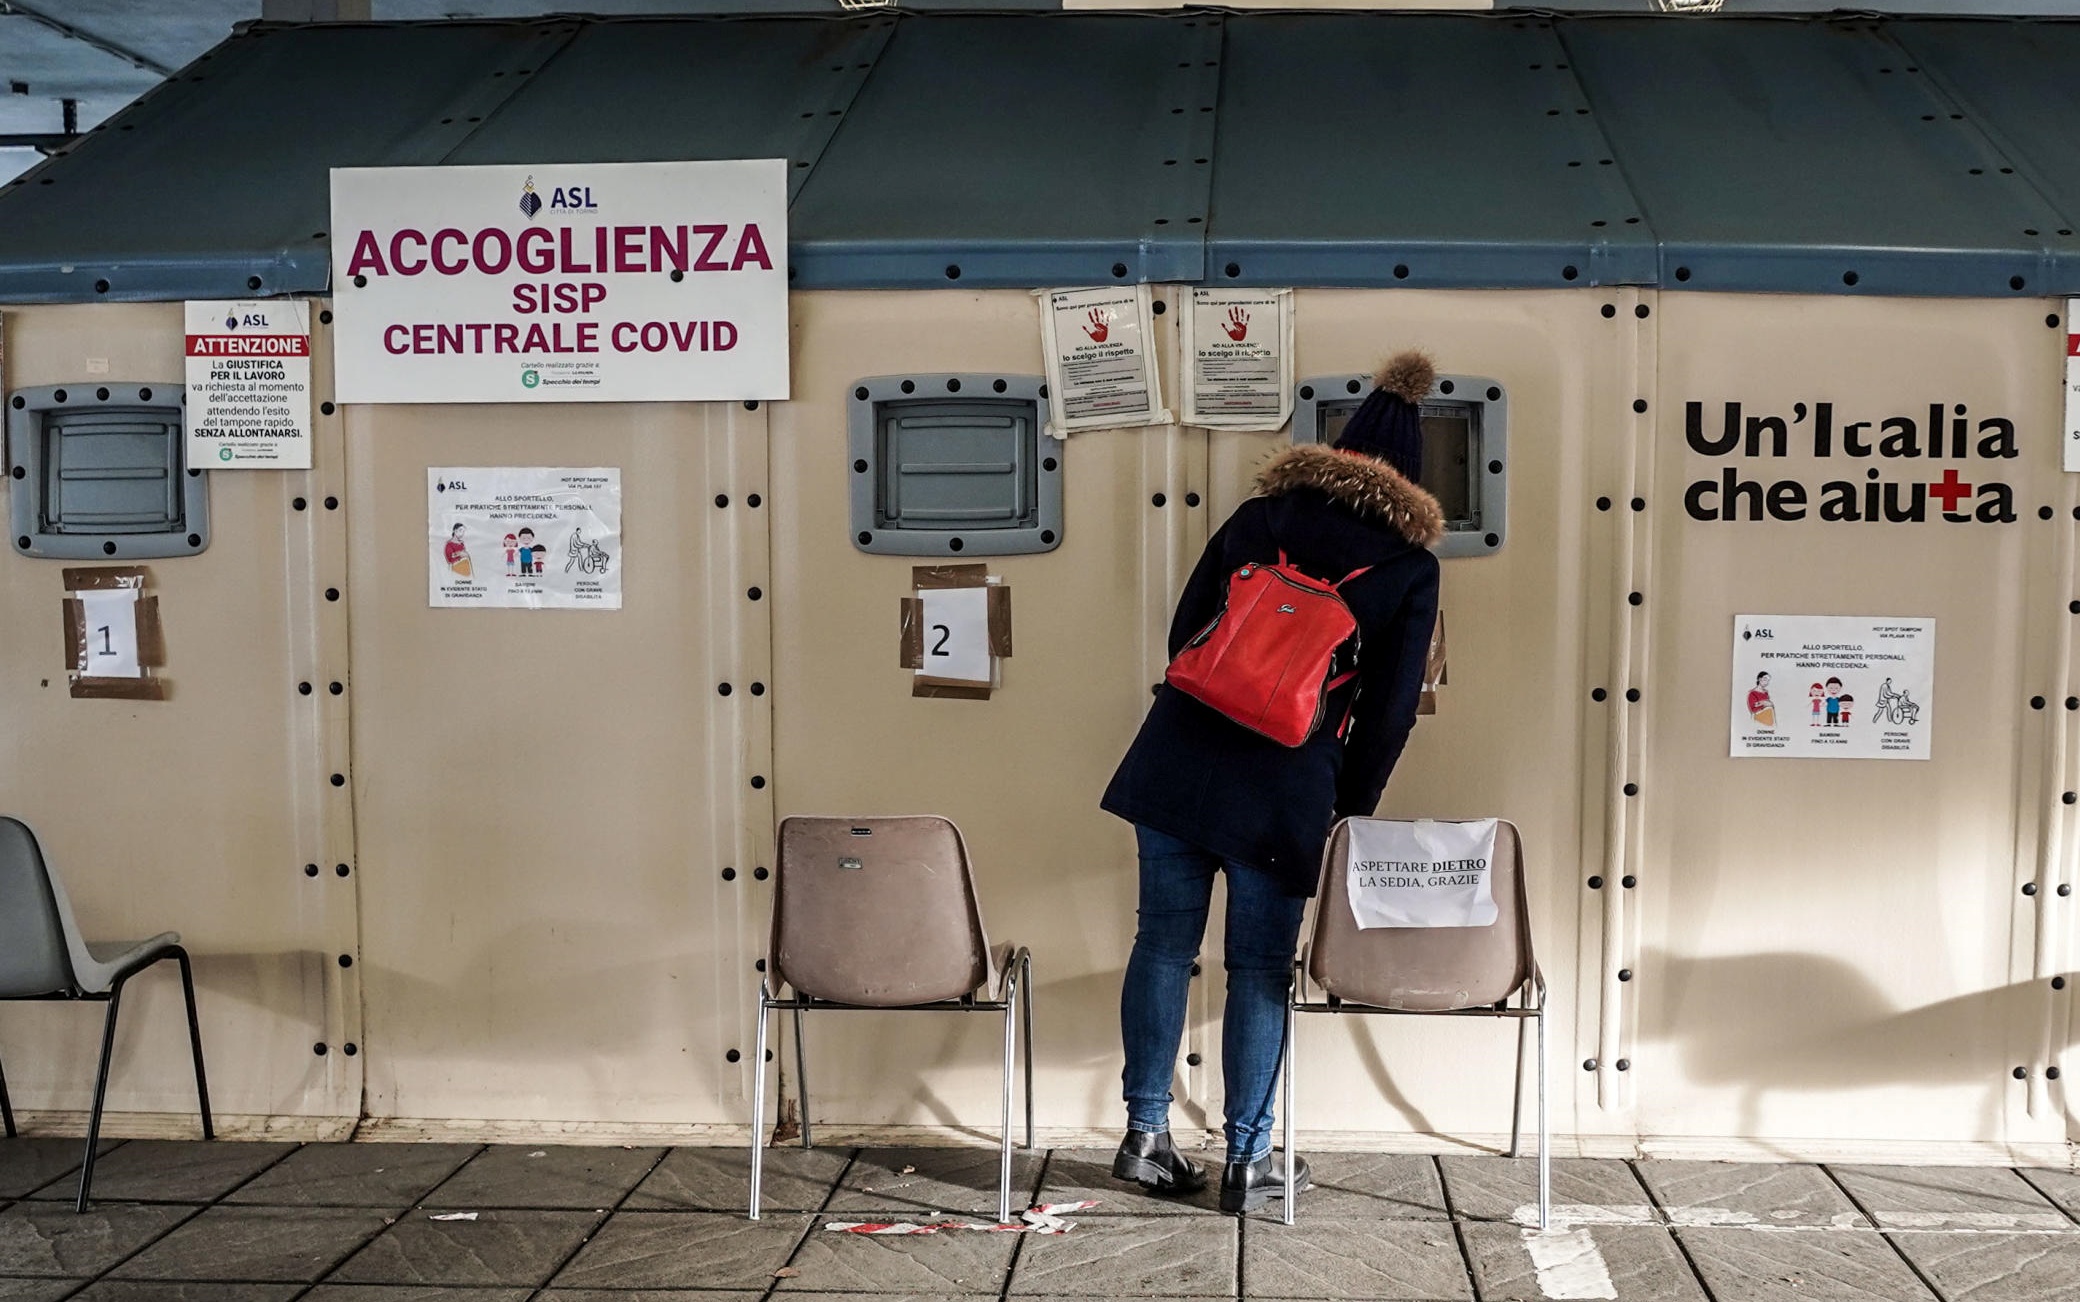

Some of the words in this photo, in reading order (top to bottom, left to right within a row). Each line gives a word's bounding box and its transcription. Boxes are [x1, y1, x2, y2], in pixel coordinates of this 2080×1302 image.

[551, 187, 597, 208] ASL
[347, 223, 773, 276] ACCOGLIENZA
[513, 283, 606, 314] SISP
[243, 314, 268, 326] ASL
[384, 323, 599, 354] CENTRALE
[611, 321, 737, 353] COVID
[194, 338, 302, 353] ATTENZIONE
[1072, 351, 1096, 361] scelgo
[1105, 348, 1134, 357] rispetto
[213, 360, 224, 369] La
[226, 360, 283, 369] GIUSTIFICA
[211, 371, 230, 380] PER
[233, 371, 241, 380] IL
[244, 371, 285, 380] LAVORO
[205, 382, 245, 391] richiesta
[248, 382, 256, 391] al
[209, 394, 287, 402] dell'accettazione
[207, 407, 260, 415] attendendo
[263, 407, 290, 415] l'esito
[203, 418, 217, 427] del
[220, 419, 261, 428] tampone
[264, 418, 293, 428] rapido
[195, 429, 225, 437] SENZA
[228, 429, 302, 438] ALLONTANARSI.
[449, 482, 467, 490] ASL
[1684, 467, 1807, 521] che
[1755, 629, 1774, 638] ASL
[98, 626, 117, 655] 1
[931, 625, 950, 656] 2
[1353, 861, 1428, 872] ASPETTARE
[1432, 859, 1486, 873] DIETRO
[1359, 878, 1376, 887] LA
[1380, 877, 1424, 888] SEDIA,
[1428, 875, 1479, 887] GRAZIE
